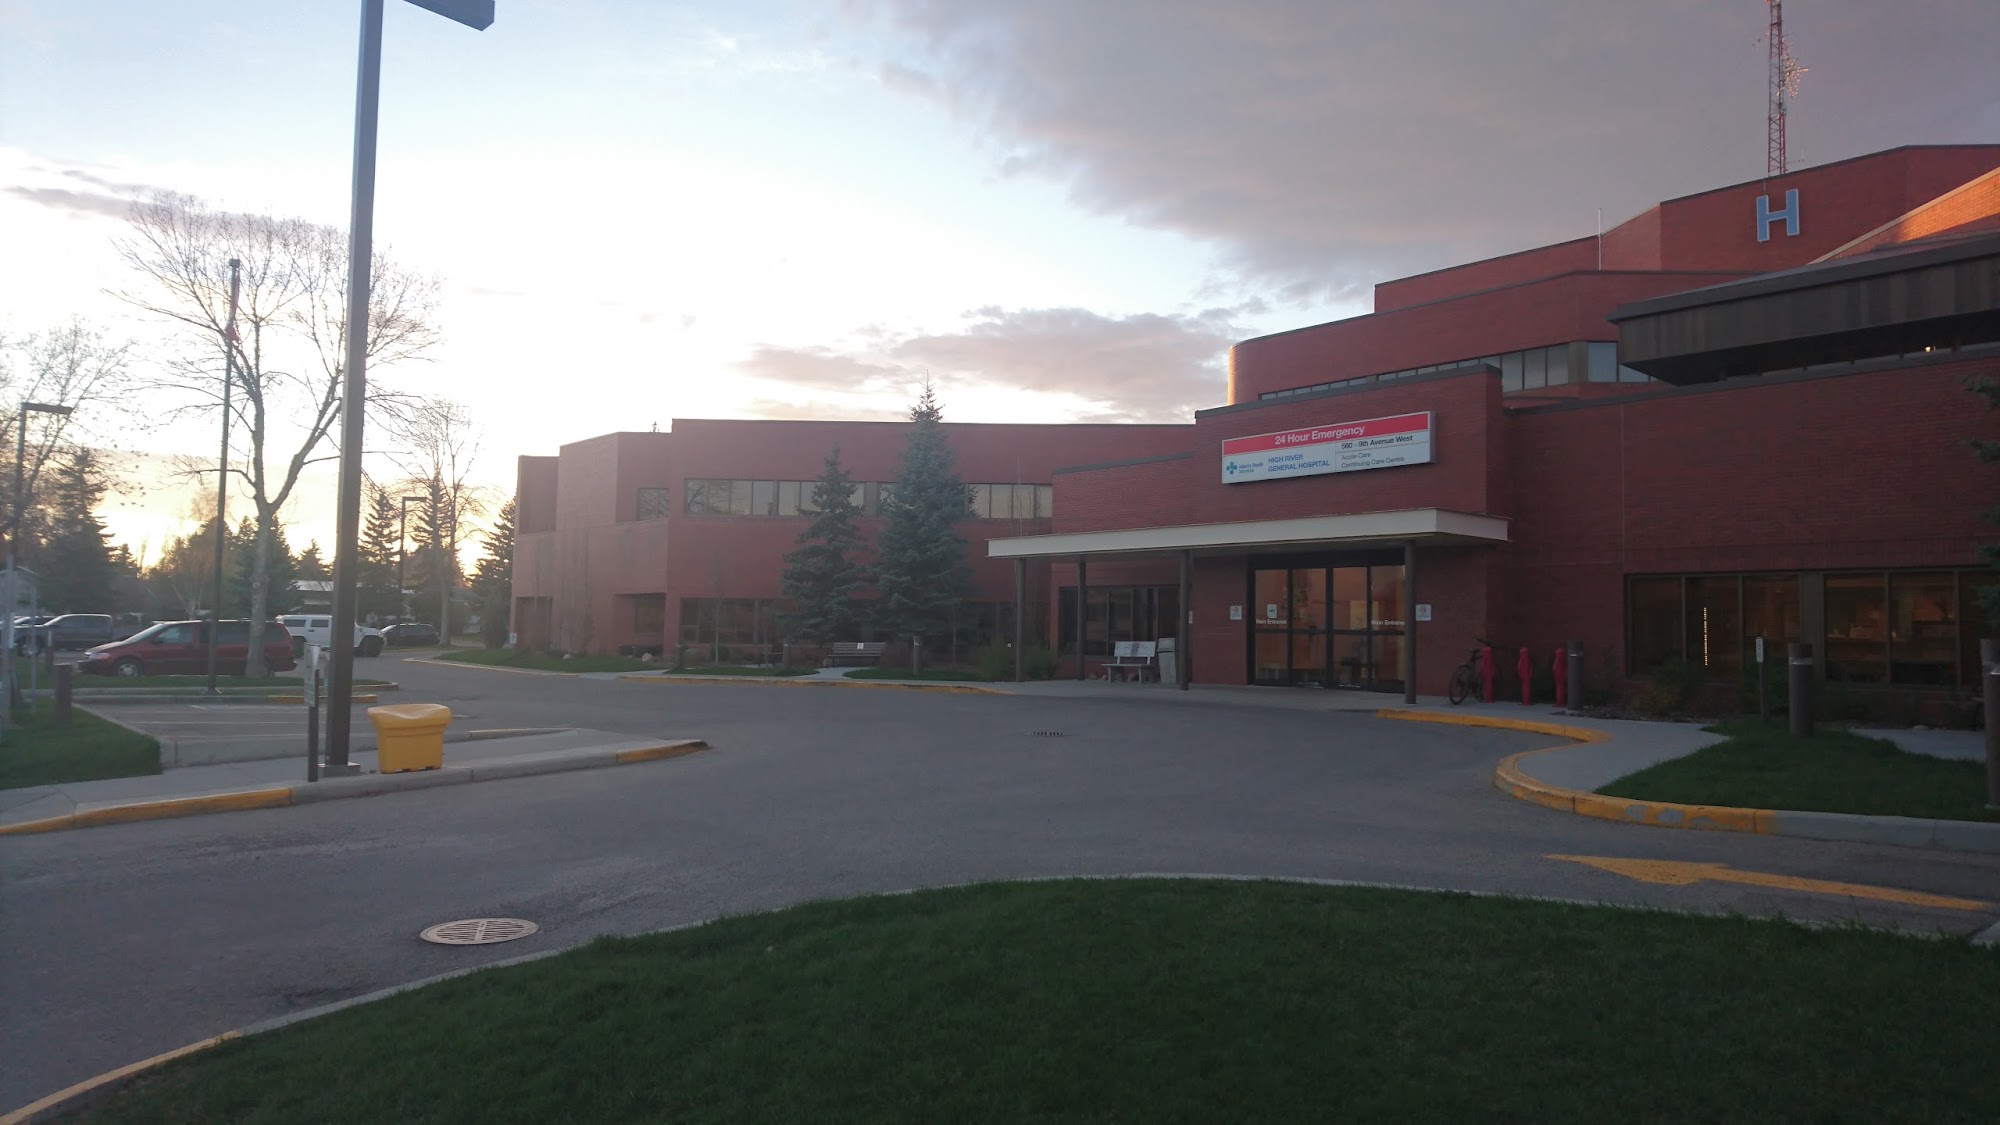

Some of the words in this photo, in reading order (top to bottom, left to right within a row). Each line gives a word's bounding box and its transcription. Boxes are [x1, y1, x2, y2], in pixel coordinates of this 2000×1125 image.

[1756, 188, 1799, 242] H
[1274, 435, 1286, 445] 24
[1287, 433, 1310, 443] Hour
[1311, 426, 1366, 440] Emergency
[1358, 440, 1369, 448] 9th
[1370, 438, 1395, 446] Avenue
[1395, 435, 1413, 443] West
[1268, 456, 1284, 464] HIGH
[1285, 454, 1304, 462] RIVER
[1341, 460, 1370, 469] Continuing
[1268, 463, 1297, 472] GENERAL
[1298, 460, 1330, 469] HOSPITAL
